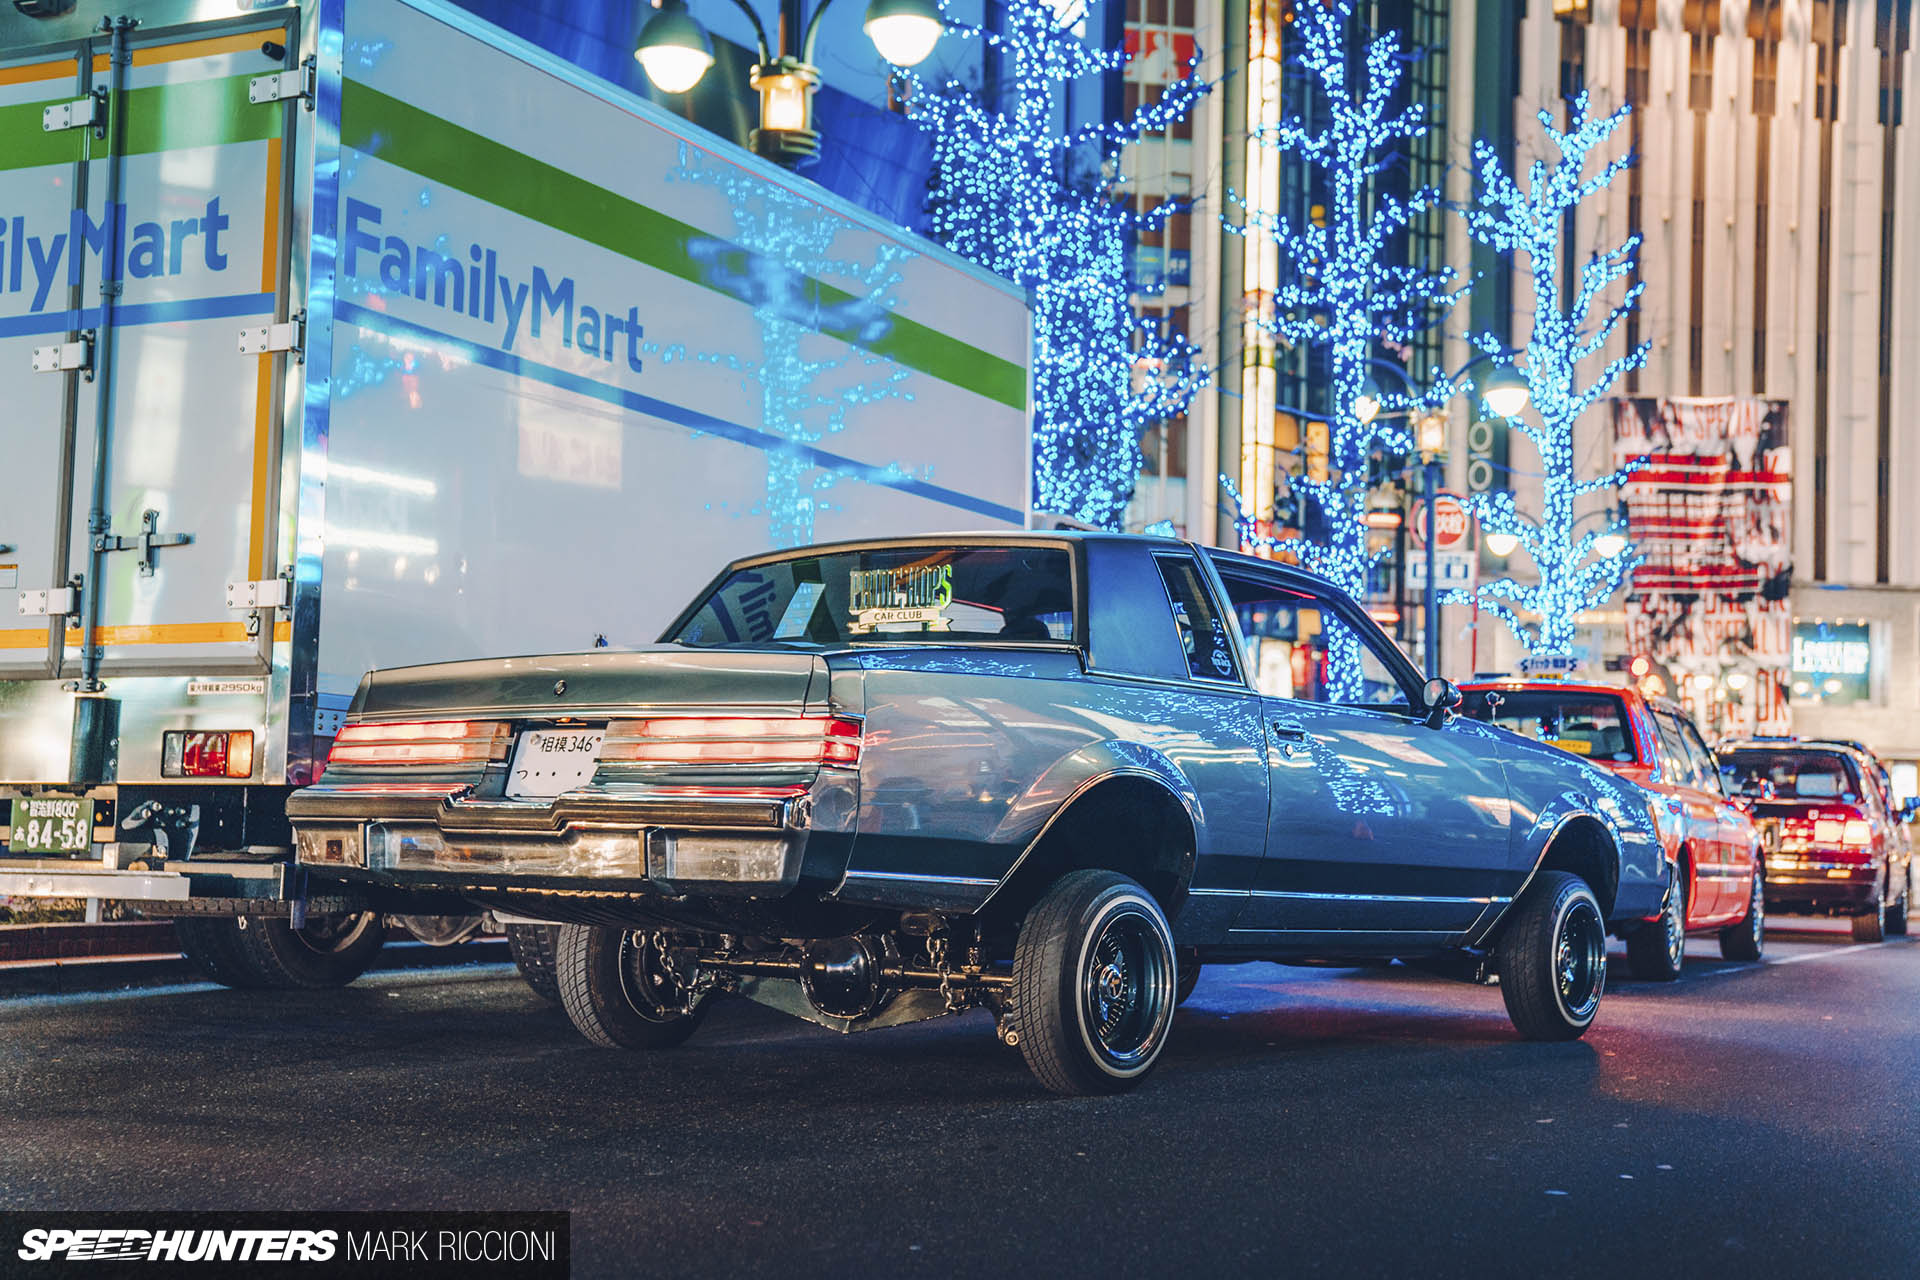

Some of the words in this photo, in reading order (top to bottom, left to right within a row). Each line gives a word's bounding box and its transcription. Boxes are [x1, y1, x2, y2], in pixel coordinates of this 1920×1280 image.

[343, 196, 644, 374] FamilyMart
[874, 612, 894, 621] CAR
[897, 610, 922, 620] CLUB
[27, 819, 88, 849] 84-58
